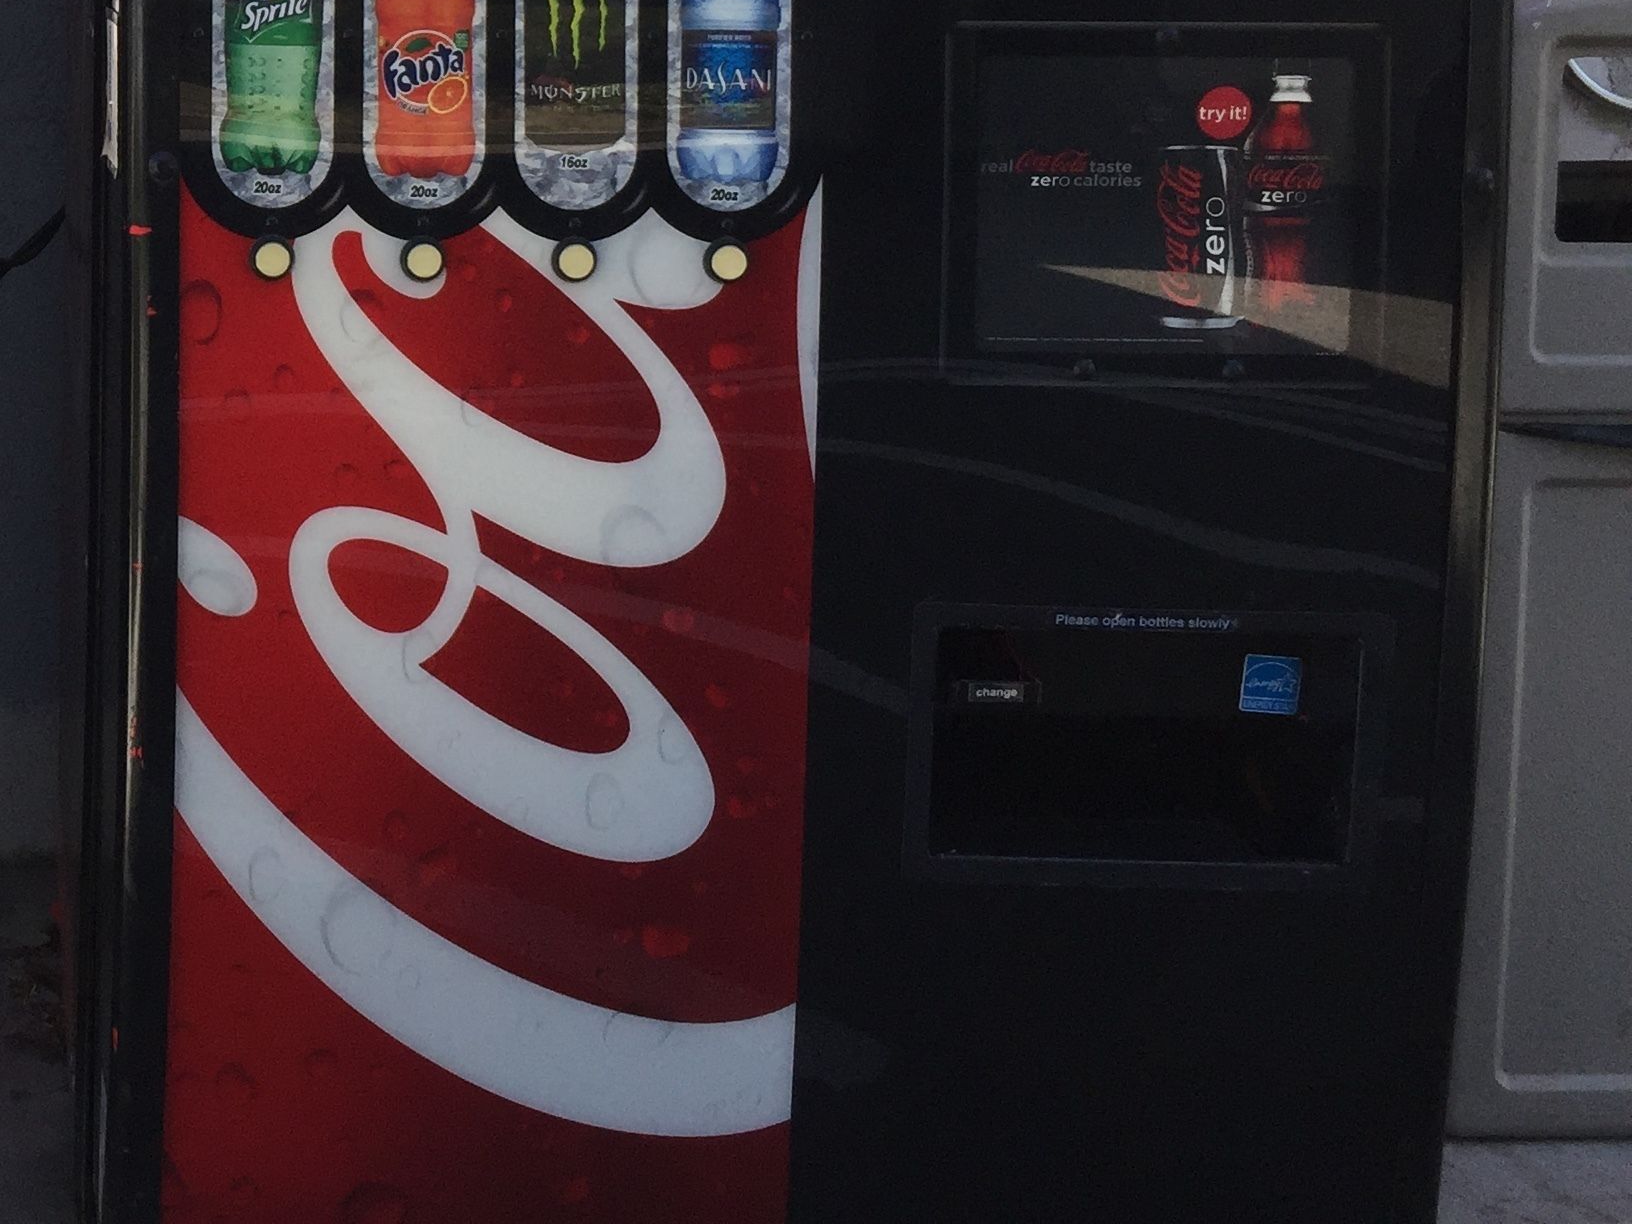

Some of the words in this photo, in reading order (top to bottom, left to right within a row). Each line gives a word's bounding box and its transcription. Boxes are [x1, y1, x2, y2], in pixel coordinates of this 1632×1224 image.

[529, 83, 622, 104] MONSTER
[1199, 105, 1227, 123] try
[1229, 105, 1248, 121] it!
[560, 155, 589, 170] 16oz
[980, 158, 1014, 174] real
[1089, 159, 1133, 174] taste
[252, 180, 282, 195] 20oz
[1030, 174, 1071, 188] zero
[1072, 174, 1142, 188] calories
[409, 184, 439, 199] 20oz
[710, 187, 739, 202] 20oz
[1260, 190, 1308, 204] zero
[1204, 195, 1226, 275] zero
[1055, 614, 1099, 627] Please
[1102, 616, 1136, 629] open
[1139, 616, 1185, 628] bottles
[1188, 616, 1231, 630] slowly
[975, 686, 1019, 699] change
